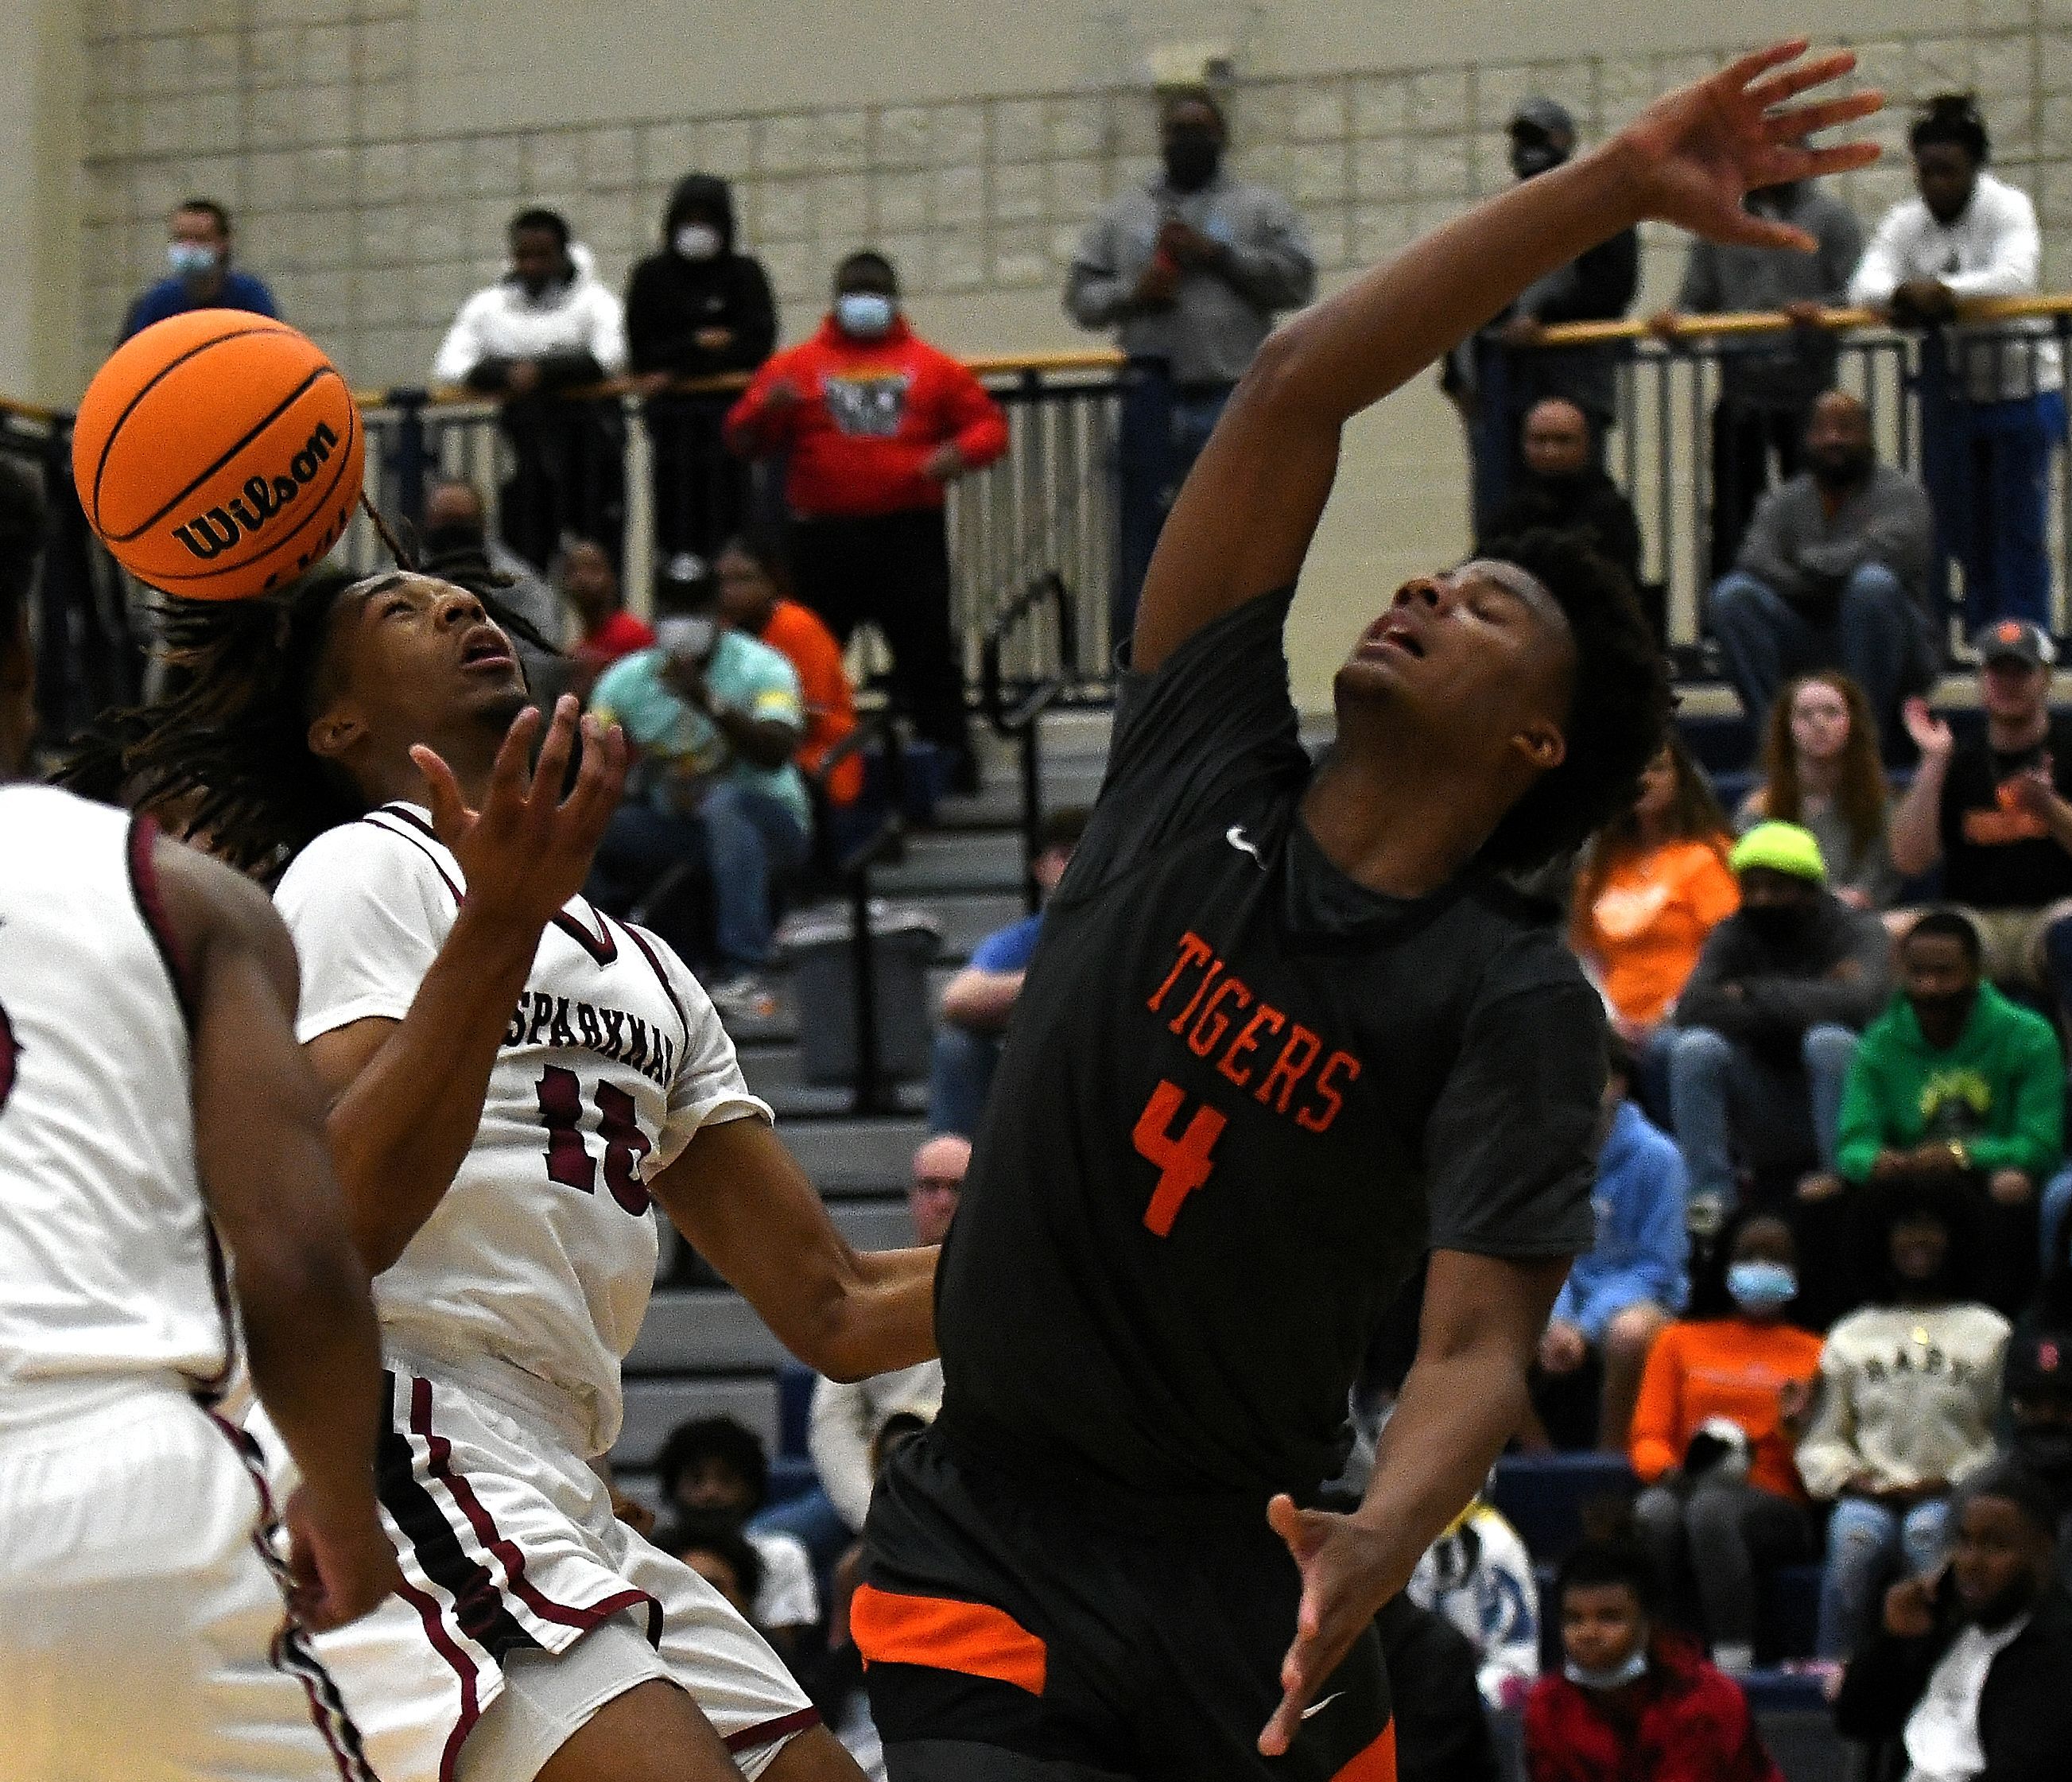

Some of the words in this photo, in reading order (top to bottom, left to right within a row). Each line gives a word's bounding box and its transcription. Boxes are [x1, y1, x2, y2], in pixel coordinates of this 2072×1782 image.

[172, 422, 340, 559] Wilson
[1146, 930, 1362, 1134] TIGERS
[1131, 1077, 1229, 1239] 4
